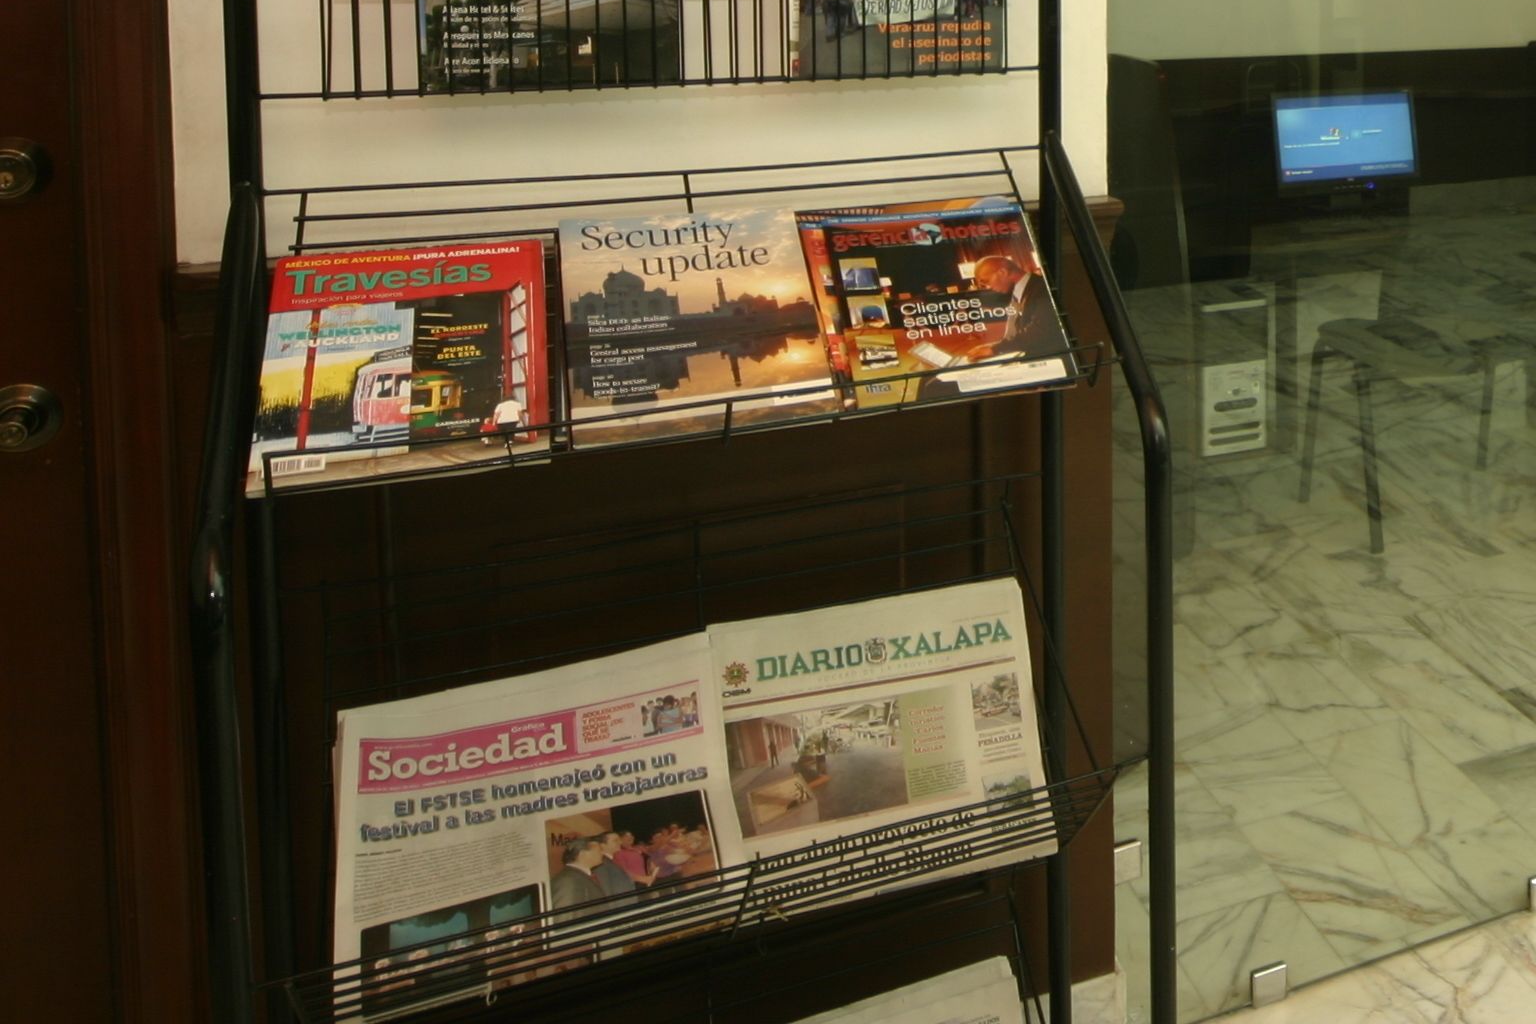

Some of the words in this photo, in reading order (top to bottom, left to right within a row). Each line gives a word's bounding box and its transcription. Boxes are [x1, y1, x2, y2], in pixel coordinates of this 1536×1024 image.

[493, 31, 535, 39] Mexcanos
[878, 22, 936, 33] Veracruz
[892, 37, 904, 48] el
[975, 35, 992, 46] de
[444, 57, 460, 65] Are
[581, 220, 733, 251] Security
[943, 219, 1022, 239] hoteles
[285, 257, 332, 269] MÉXICO
[334, 257, 349, 265] DE
[351, 254, 411, 264] AVENTURA
[448, 246, 520, 258] ADRENALINA!
[640, 244, 770, 282] update
[286, 259, 492, 295] Travesías
[292, 293, 344, 305] Inspiración
[345, 293, 367, 302] para
[369, 290, 404, 300] viajeros
[900, 296, 982, 316] Clientes
[903, 303, 1023, 328] satisfechos,
[278, 324, 401, 340] WELLINGTON
[294, 332, 400, 348] AUCKLAND
[906, 327, 933, 340] en
[938, 320, 987, 337] línea
[437, 352, 456, 360] DEL
[458, 350, 481, 358] ESTE
[443, 345, 476, 353] PUNTA
[756, 643, 863, 682] DIARIO
[888, 619, 1012, 660] XALAPA
[368, 723, 567, 781] Sociedad
[394, 799, 414, 818] El
[421, 789, 487, 815] FSTSE
[491, 764, 606, 800] homenajeó
[609, 759, 647, 777] con
[651, 751, 676, 769] un
[360, 814, 439, 843] festival
[445, 813, 460, 830] a
[465, 807, 496, 826] las
[501, 787, 580, 818] madres
[583, 765, 708, 802] trabajadoras
